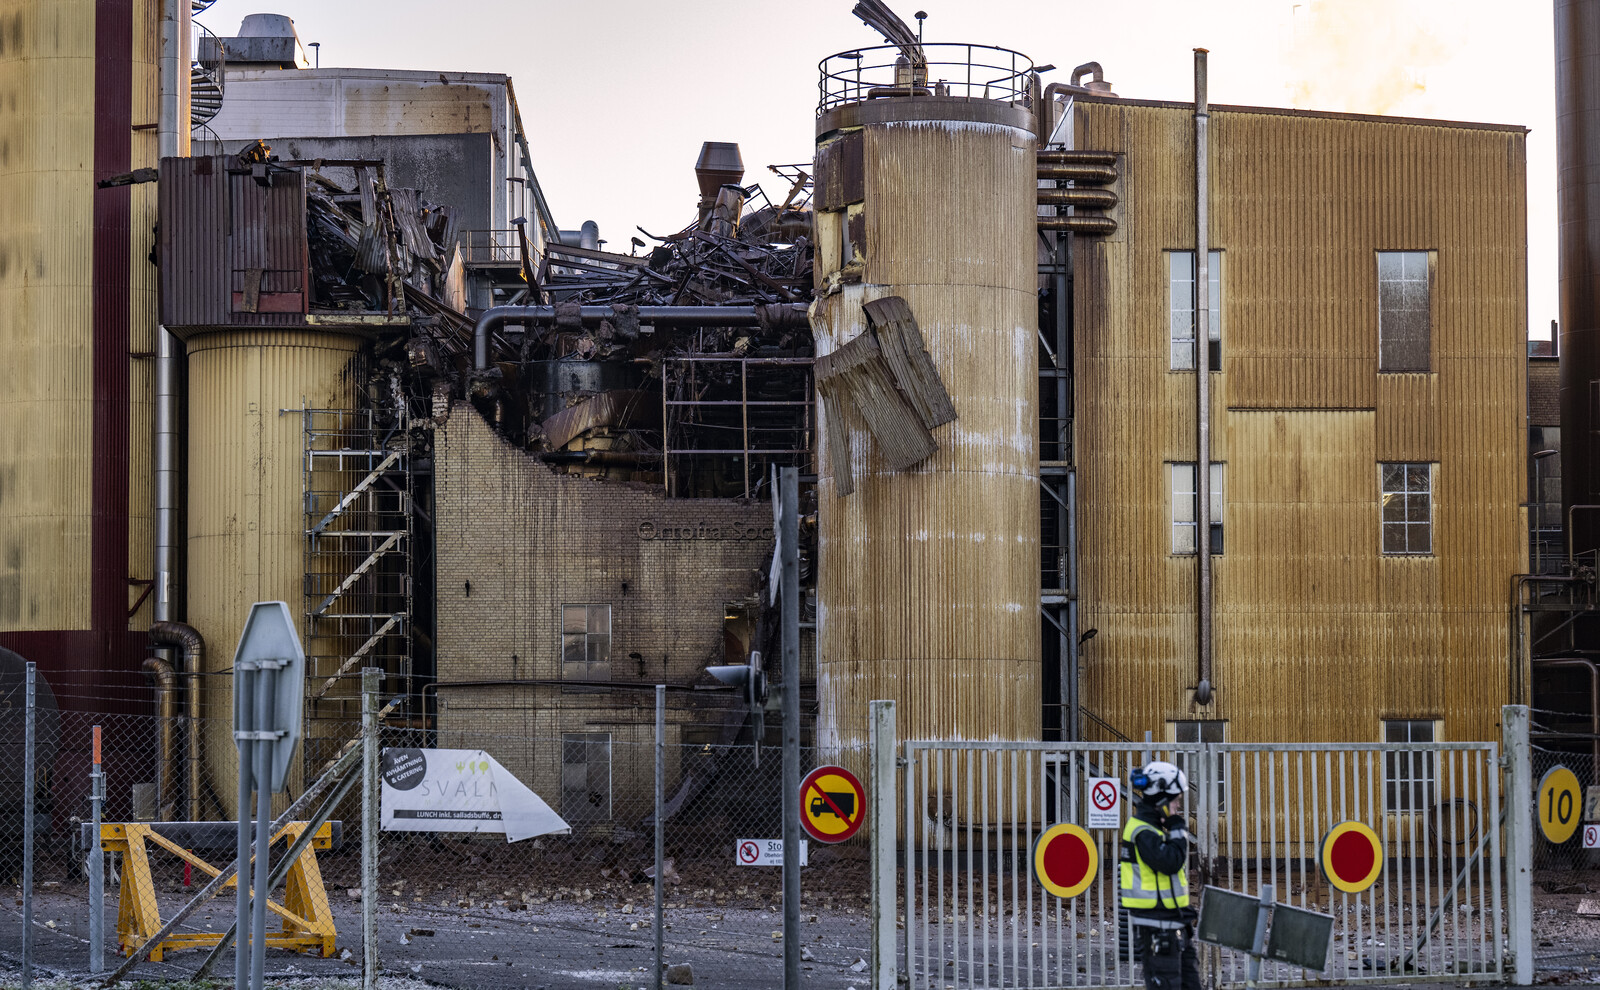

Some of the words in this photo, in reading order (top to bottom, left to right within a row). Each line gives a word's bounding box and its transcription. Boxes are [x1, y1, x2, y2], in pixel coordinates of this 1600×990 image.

[393, 754, 409, 765] ÄVEN
[386, 756, 423, 778] AVHÄMTNING
[397, 765, 423, 781] CATERING
[1548, 787, 1573, 825] 10
[453, 812, 492, 820] salladsbuffé,
[767, 841, 782, 851] Sto
